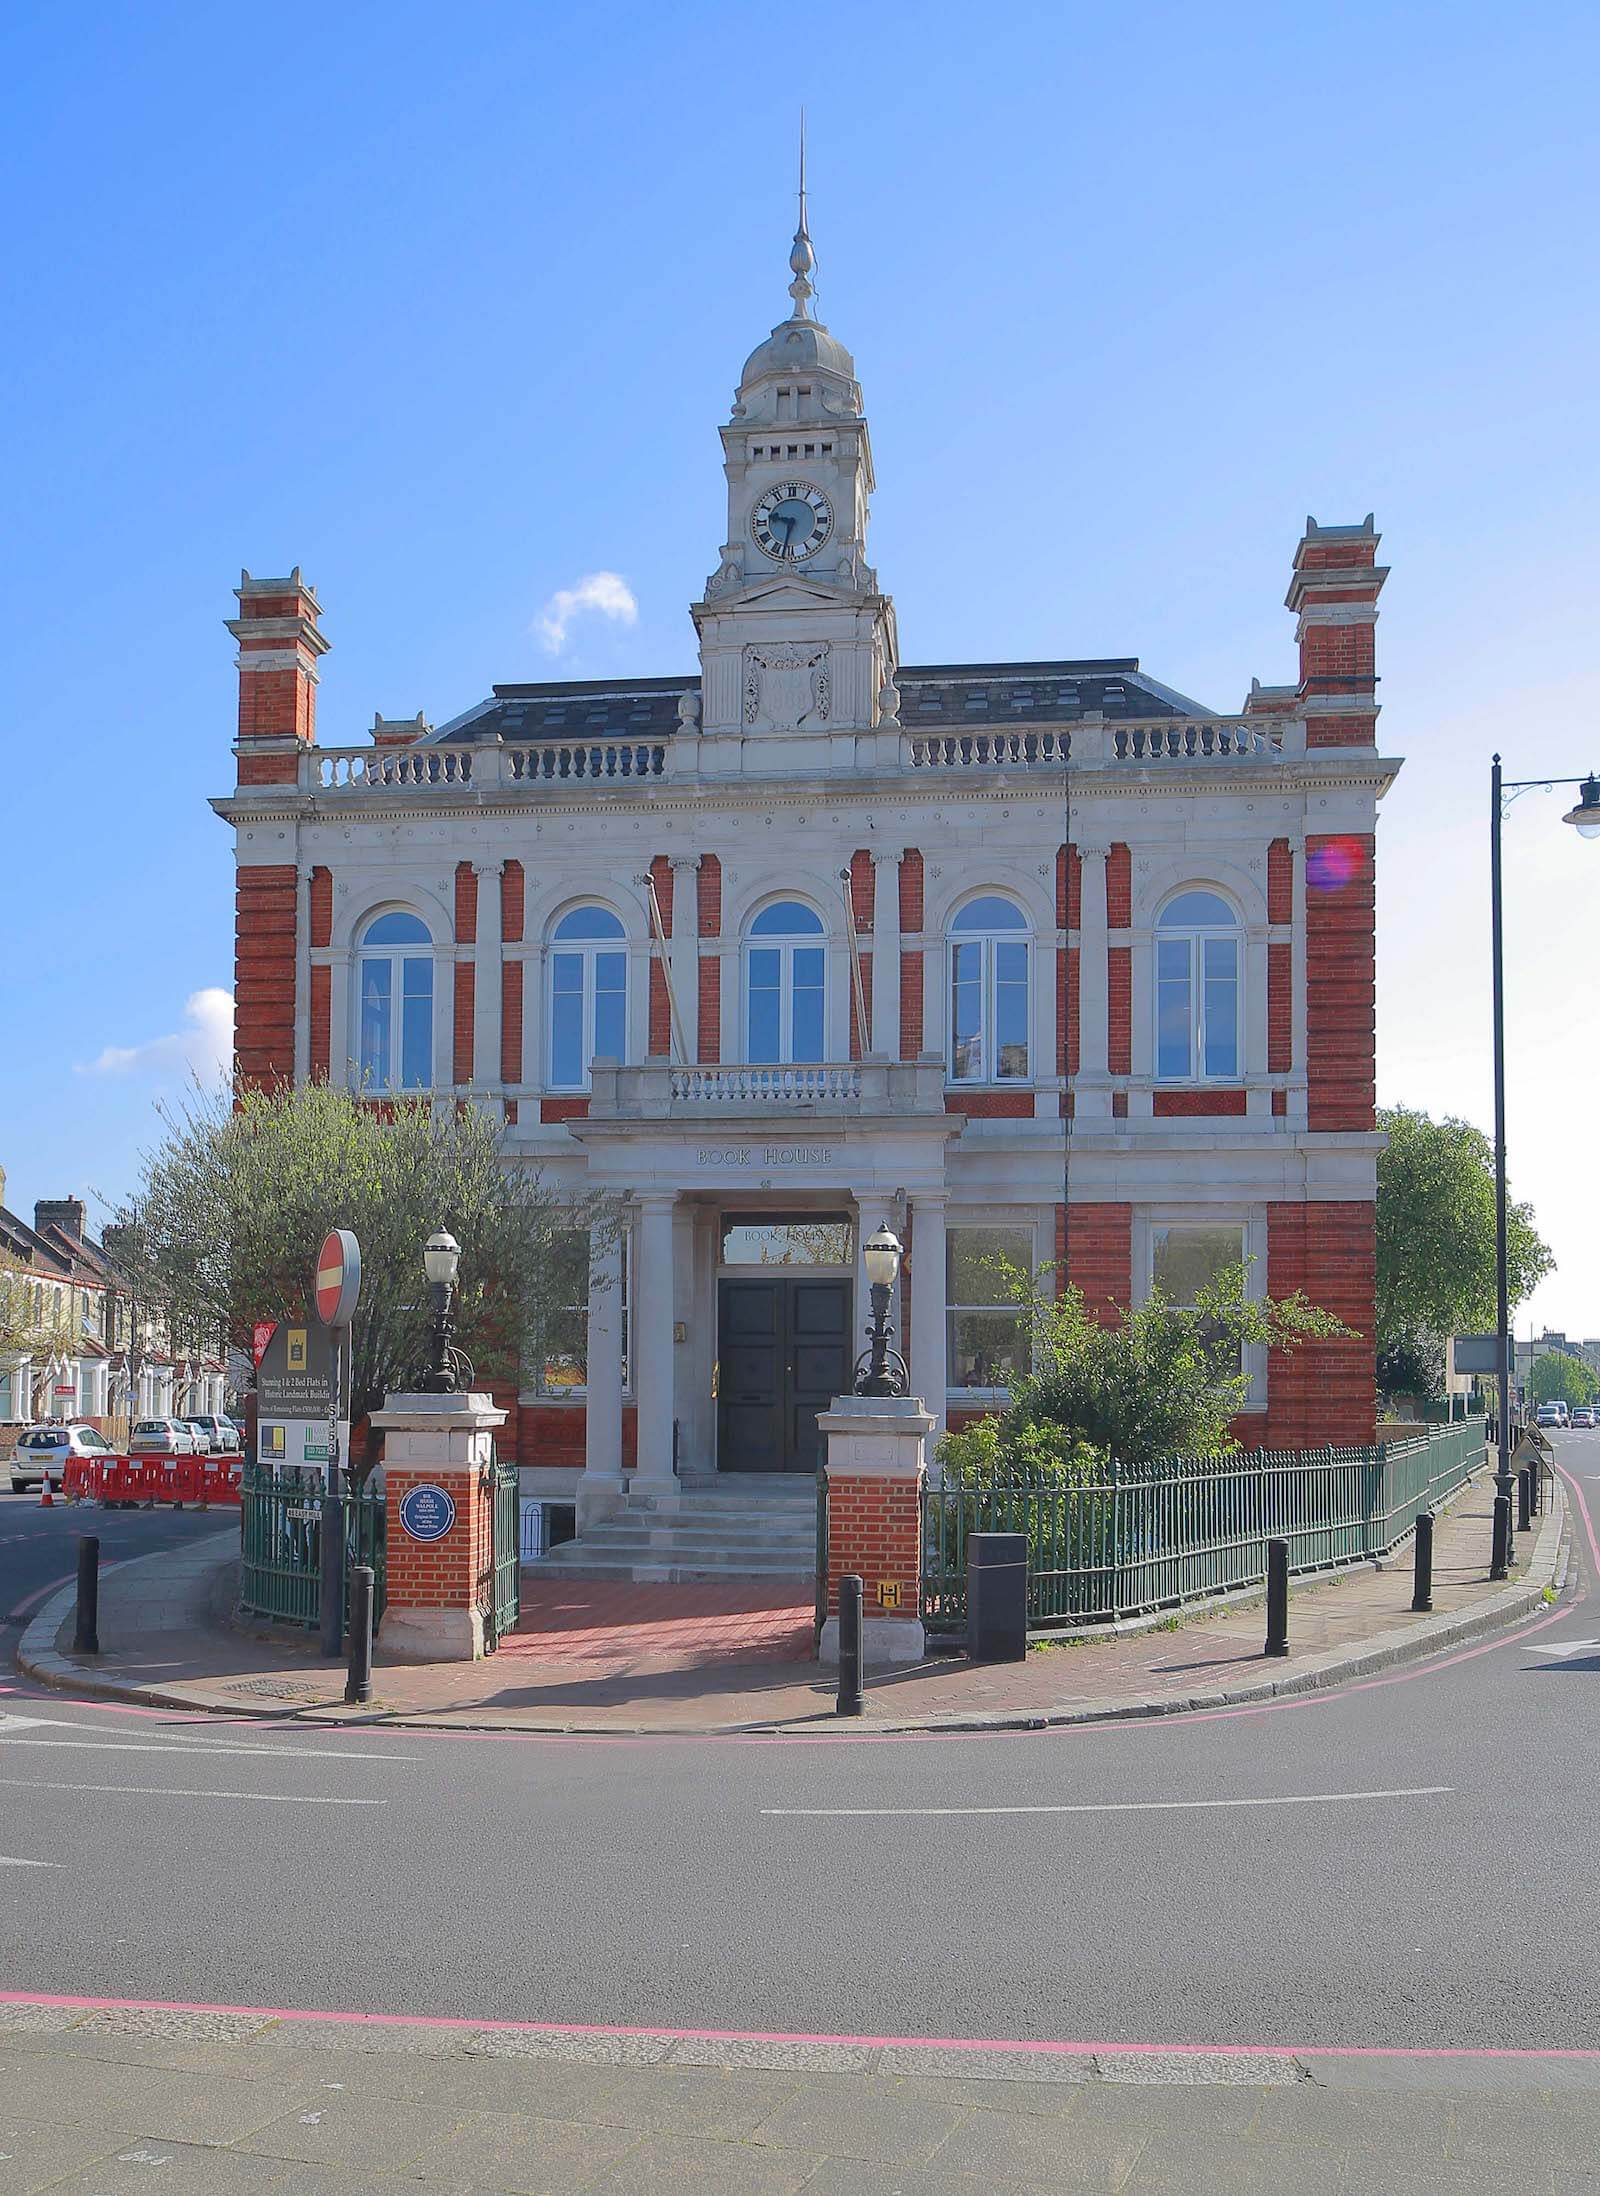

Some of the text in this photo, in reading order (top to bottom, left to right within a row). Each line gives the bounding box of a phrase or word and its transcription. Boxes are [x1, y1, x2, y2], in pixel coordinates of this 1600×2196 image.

[698, 1148, 832, 1166] BOOK HOUSE
[745, 1231, 778, 1241] BOOK
[306, 1376, 321, 1387] Flats
[282, 1389, 309, 1398] Landmark
[309, 1389, 331, 1399] Buildin
[881, 1583, 897, 1605] H
